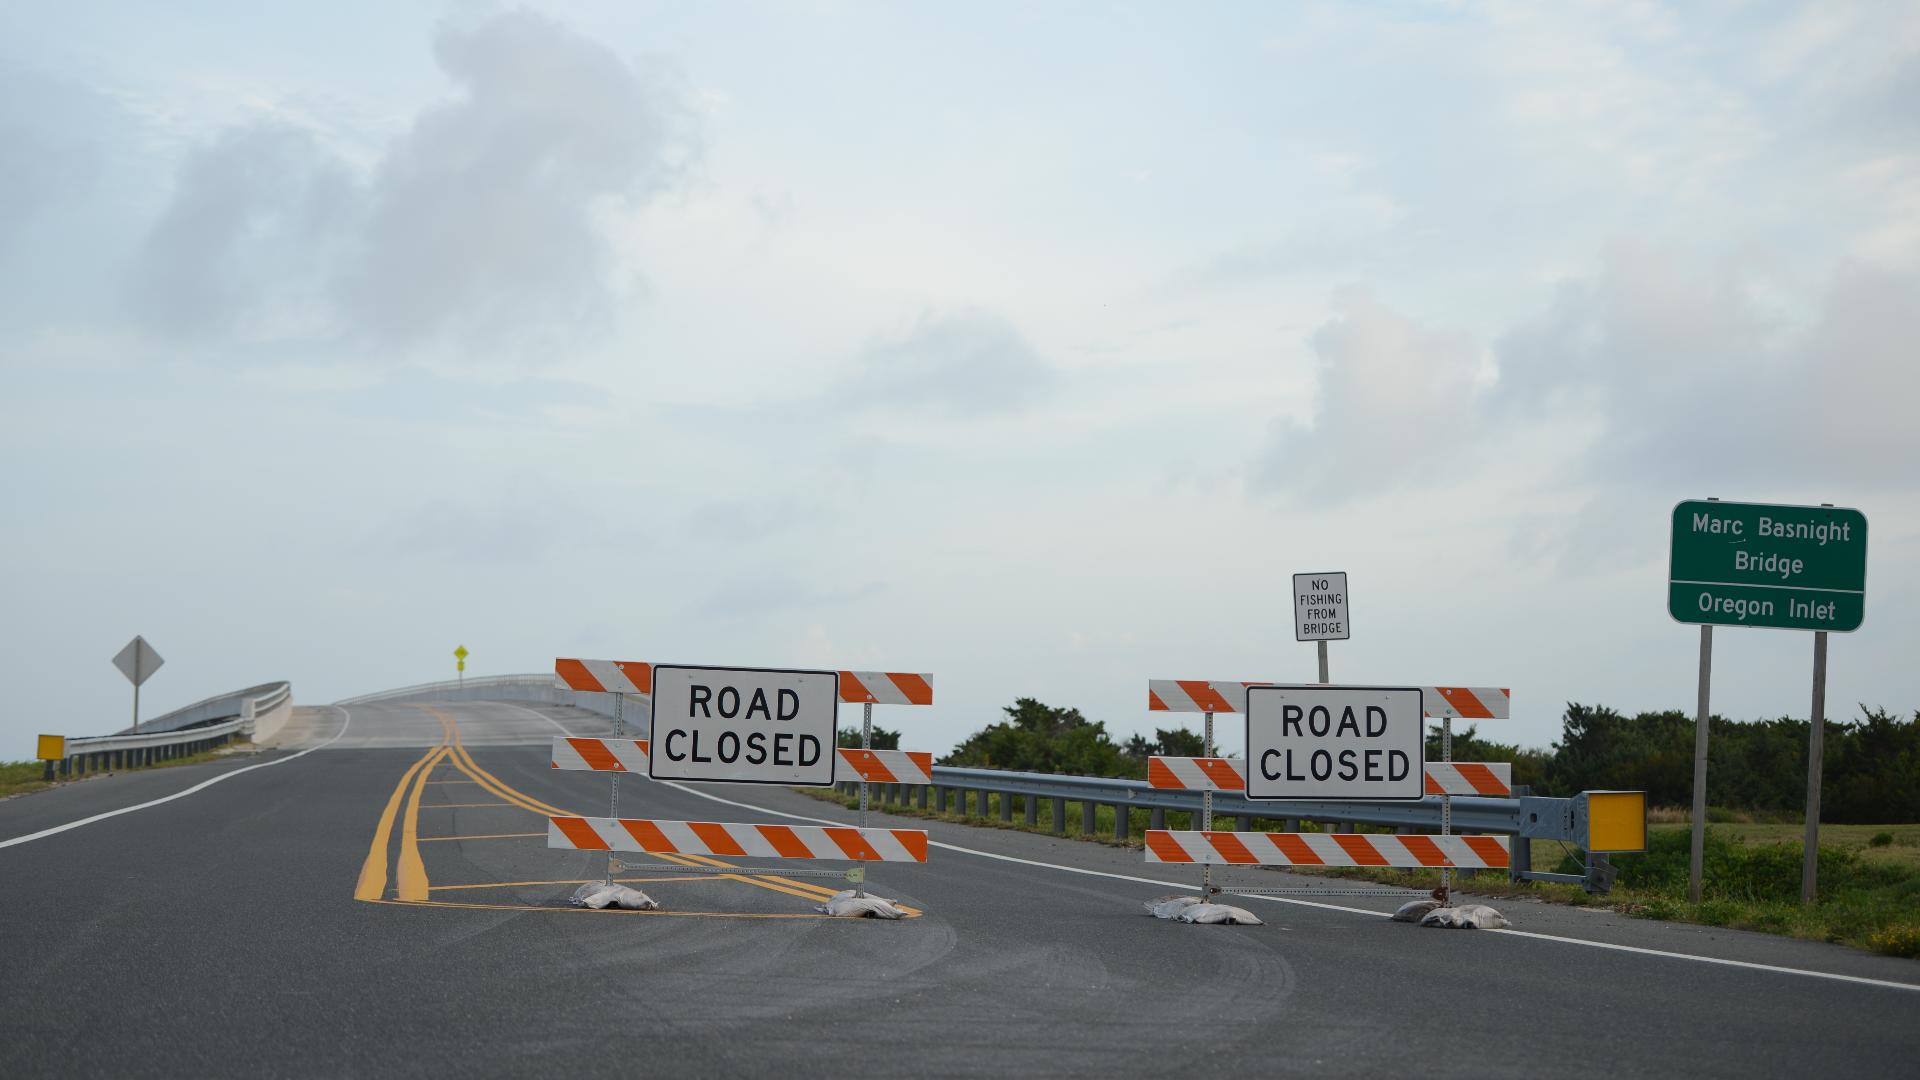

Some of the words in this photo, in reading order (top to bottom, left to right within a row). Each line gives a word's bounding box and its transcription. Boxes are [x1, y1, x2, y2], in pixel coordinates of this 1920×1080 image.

[1692, 512, 1744, 535] Marc
[1758, 516, 1851, 546] Basnight
[1735, 550, 1804, 580] Bridge
[1300, 593, 1342, 606] FISHING
[1311, 579, 1329, 591] NO
[1307, 608, 1336, 620] FROM
[1698, 592, 1774, 621] Oregon
[1789, 598, 1836, 621] Inlet
[1303, 622, 1342, 635] BRIDGE
[689, 684, 800, 721] ROAD
[1282, 704, 1388, 738] ROAD
[665, 728, 821, 767] CLOSED
[1260, 748, 1410, 782] CLOSED
